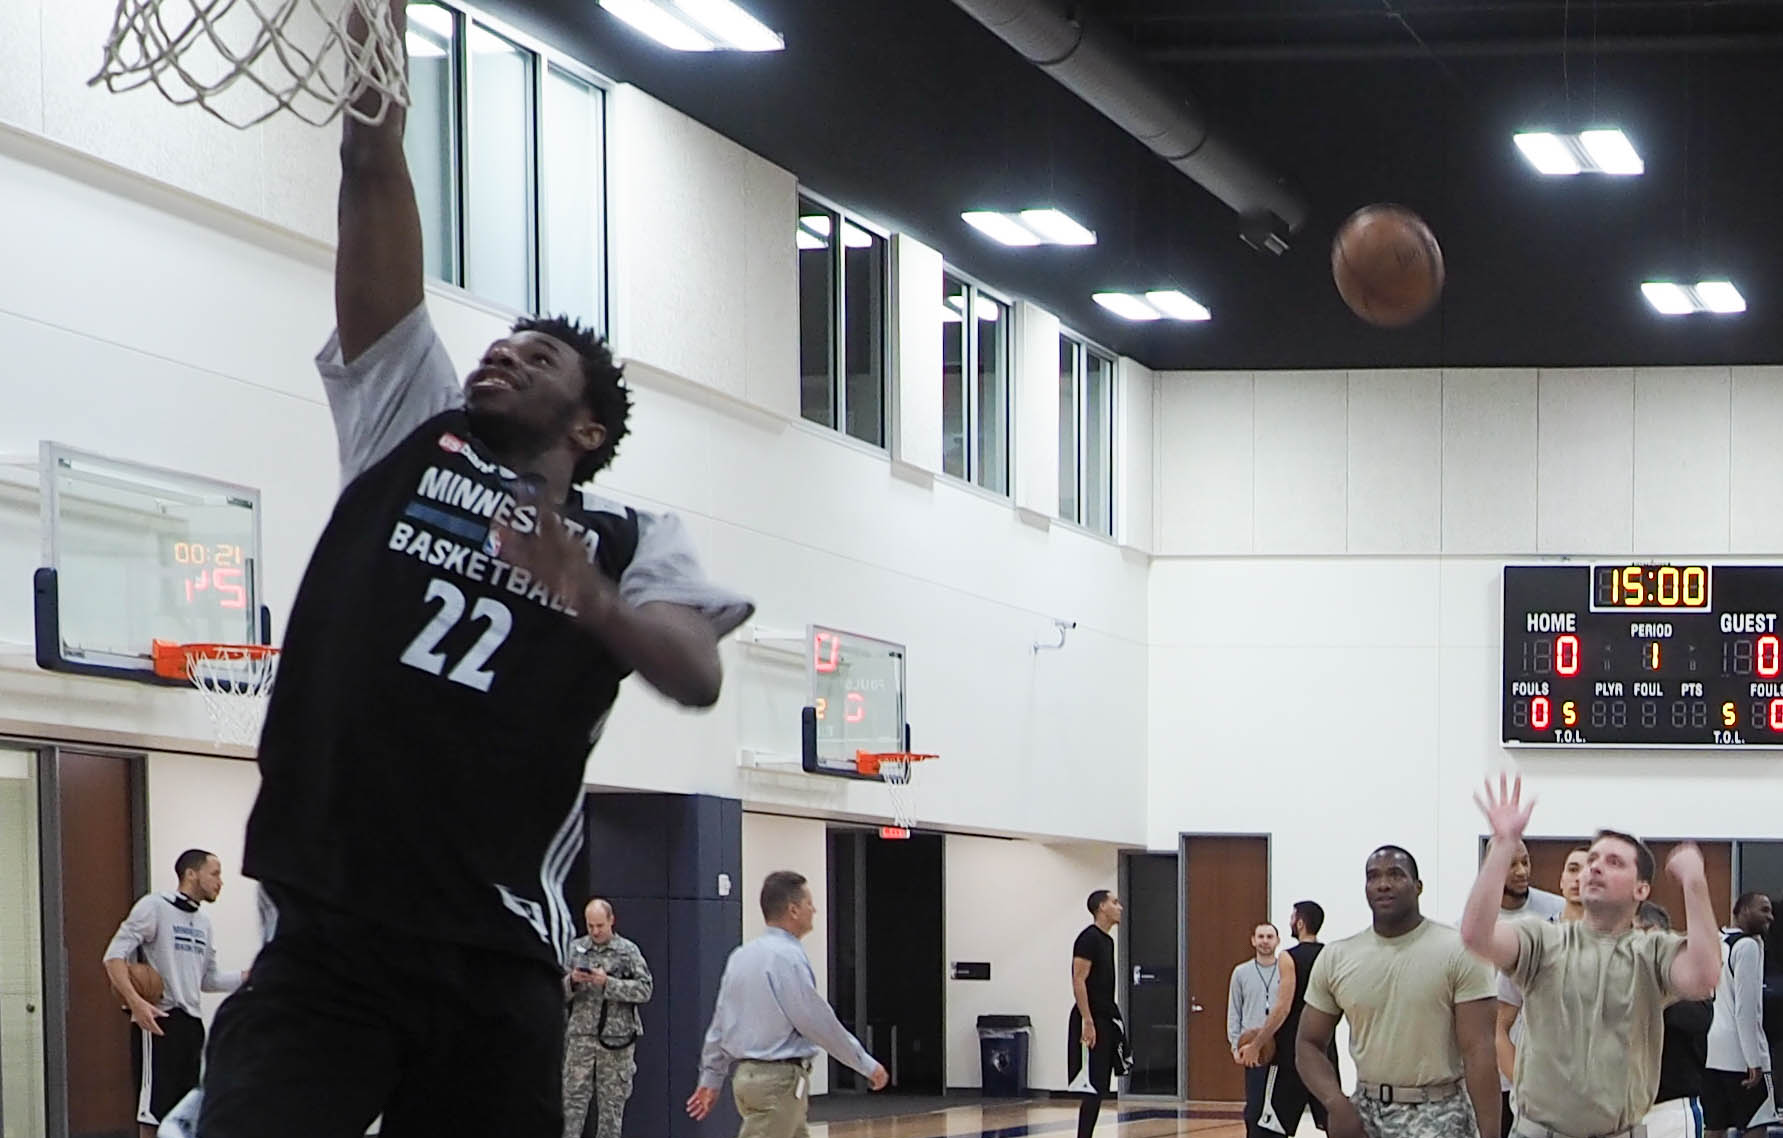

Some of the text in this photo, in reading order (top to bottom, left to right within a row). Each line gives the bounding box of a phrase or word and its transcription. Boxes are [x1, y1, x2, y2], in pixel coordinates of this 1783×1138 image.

[417, 466, 600, 565] MINNESTA
[1611, 566, 1705, 606] 15:00
[1526, 612, 1577, 633] HOME
[1630, 623, 1673, 638] PERIOD
[1719, 612, 1777, 633] GUEST
[400, 578, 513, 692] 22
[1556, 635, 1579, 675] 0
[1651, 642, 1660, 670] 1
[1757, 635, 1780, 676] 0
[1512, 682, 1550, 697] FOULS
[1594, 682, 1704, 697] PLYR FOUL PTS
[1531, 697, 1550, 729] 0
[1554, 730, 1586, 744] T.O.L.
[1712, 730, 1745, 744] T.O.L.
